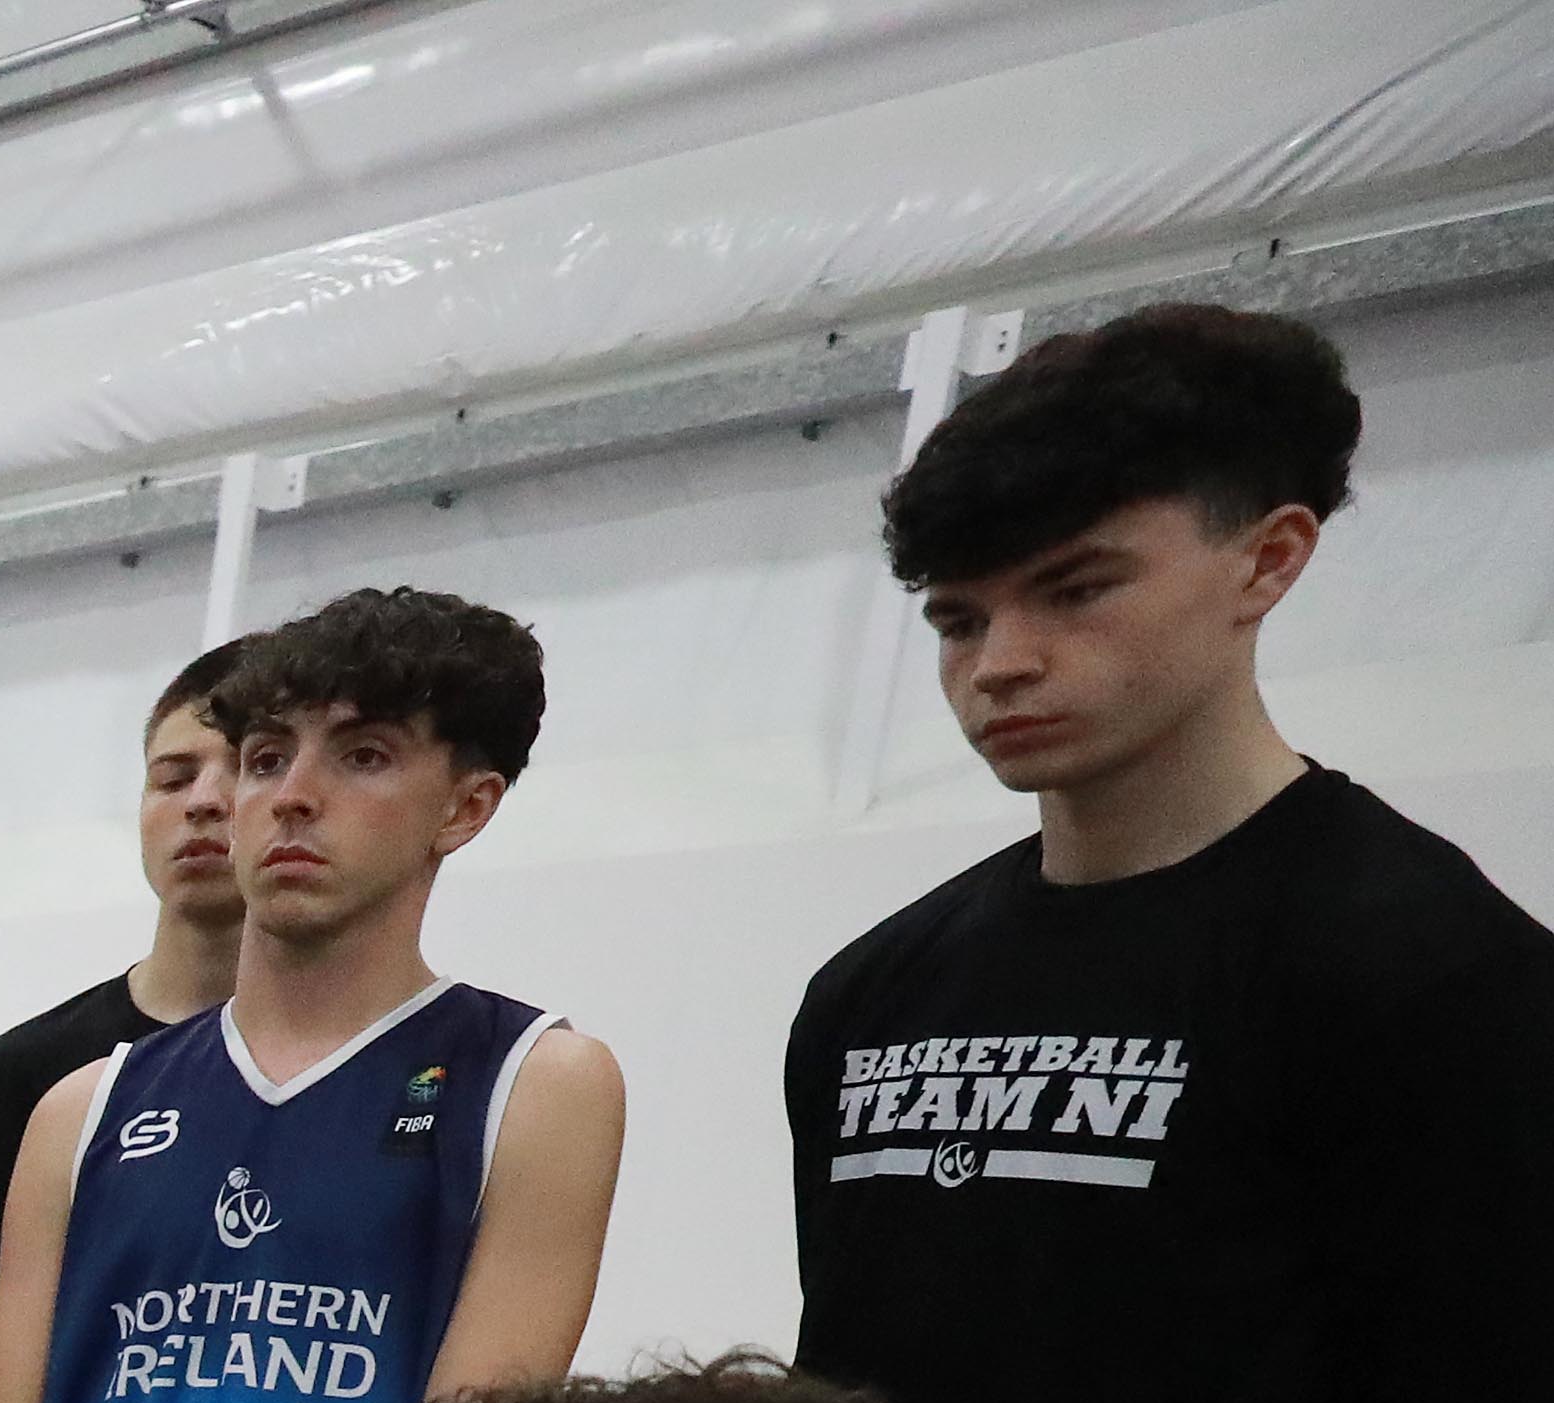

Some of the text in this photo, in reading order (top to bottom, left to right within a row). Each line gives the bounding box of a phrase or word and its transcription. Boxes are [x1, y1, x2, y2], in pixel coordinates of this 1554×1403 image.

[841, 1036, 1190, 1084] BASKETBALL
[394, 1114, 435, 1133] FIBA
[838, 1076, 1185, 1140] TEAM NI
